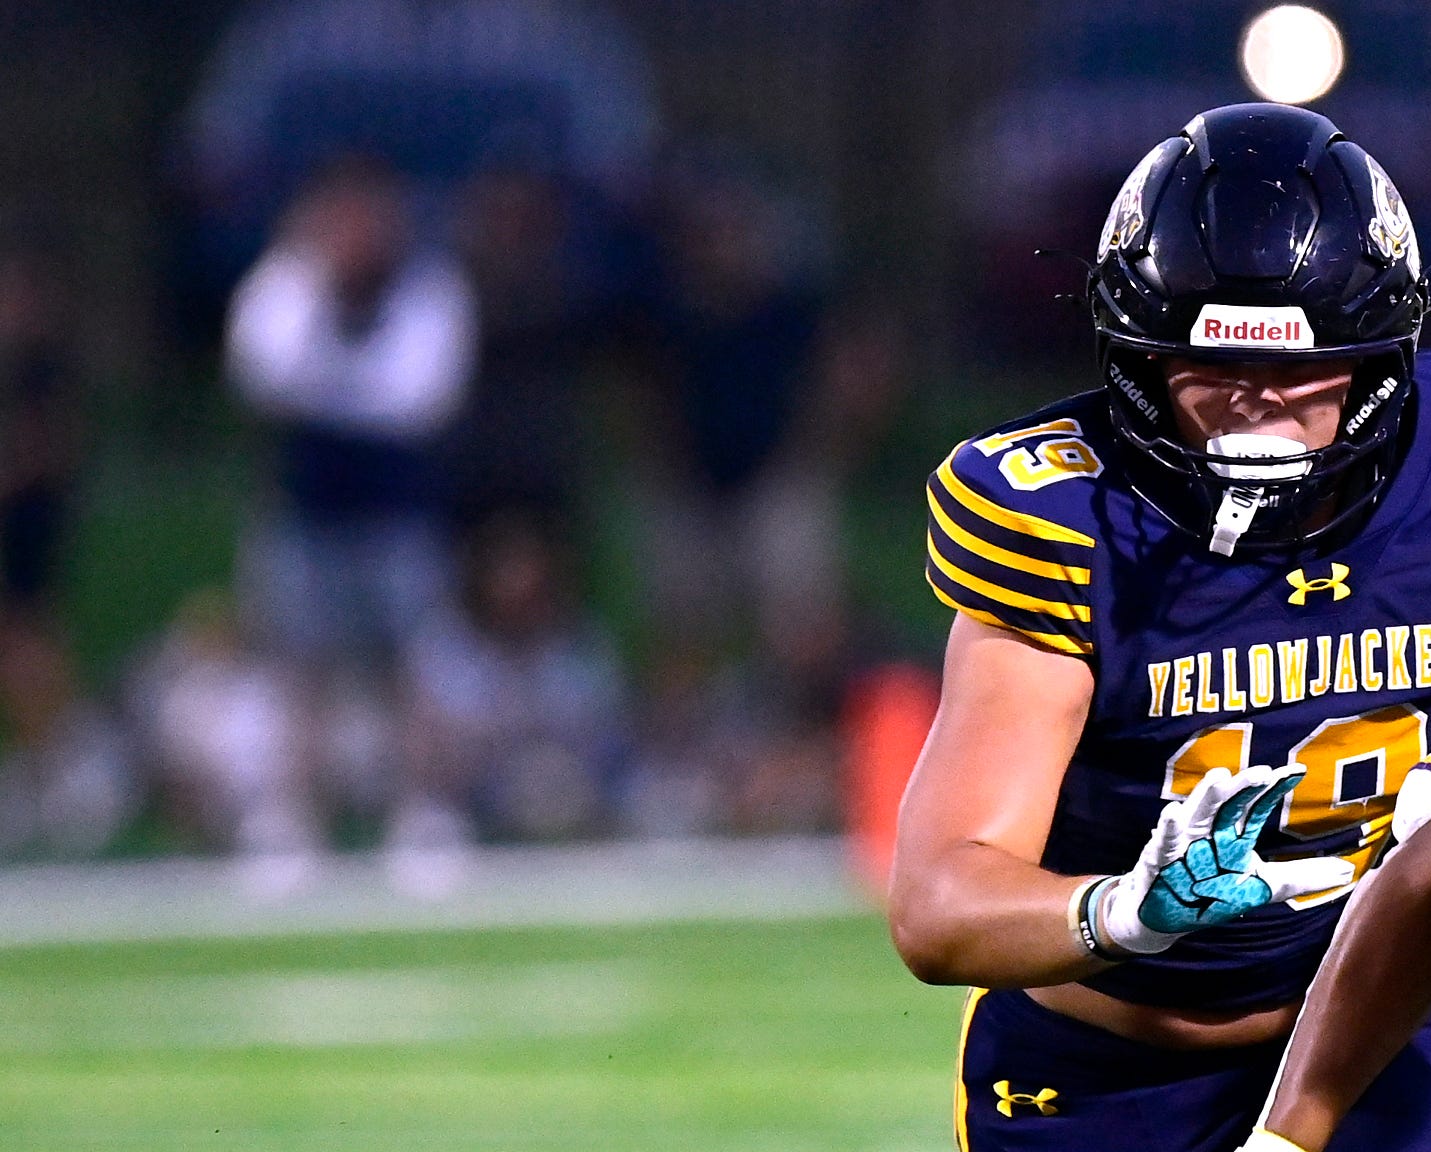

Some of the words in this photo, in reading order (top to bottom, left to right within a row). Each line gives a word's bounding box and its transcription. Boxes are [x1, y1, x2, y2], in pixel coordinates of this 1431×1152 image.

[1203, 319, 1300, 341] Riddell
[1109, 362, 1157, 424] Riddell
[1345, 376, 1398, 436] Riddell
[971, 418, 1105, 492] 19
